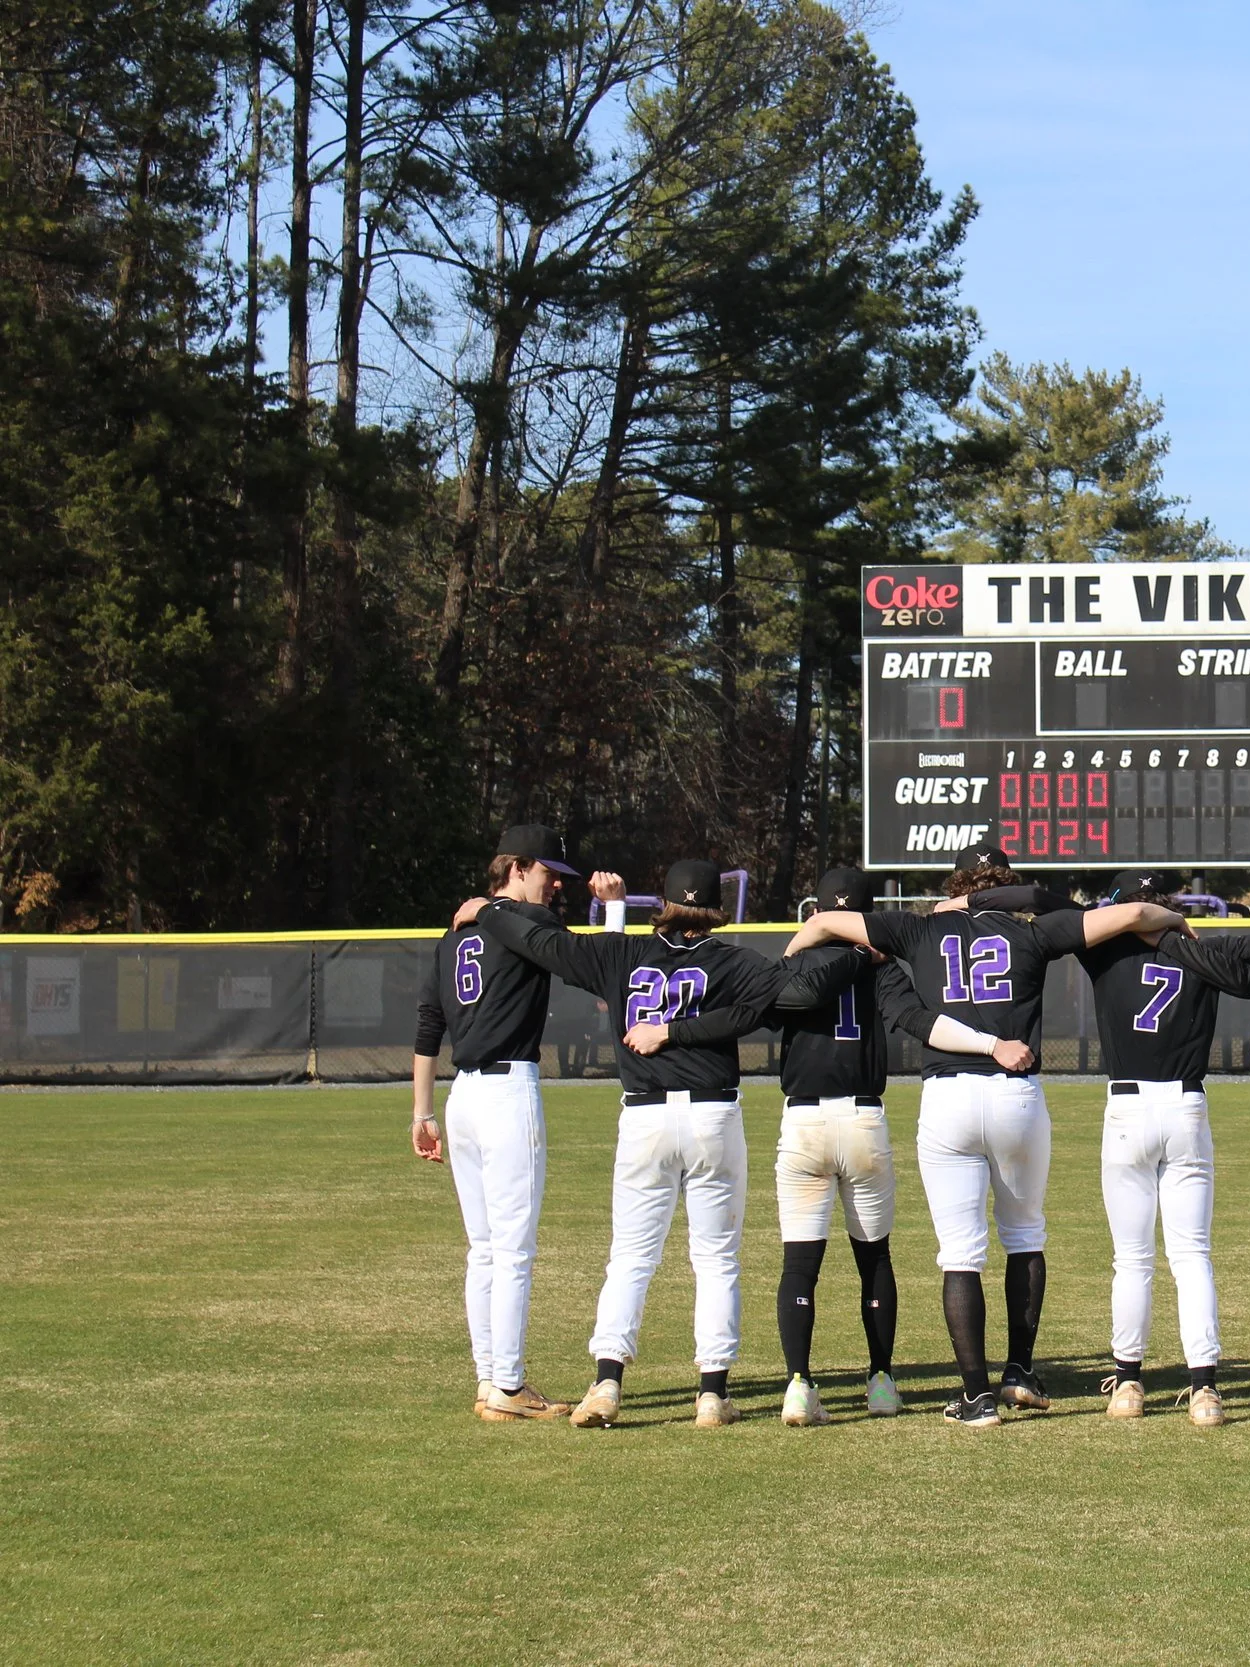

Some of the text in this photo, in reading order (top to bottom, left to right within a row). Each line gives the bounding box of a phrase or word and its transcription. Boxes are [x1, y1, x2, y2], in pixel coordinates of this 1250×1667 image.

[866, 575, 959, 609] Coke
[988, 576, 1102, 623] THE
[881, 608, 944, 626] zero
[881, 651, 993, 679] BATTER
[1054, 649, 1128, 677] BALL
[939, 687, 965, 729] 0
[1006, 751, 1015, 769] 1
[1033, 751, 1047, 769] 2
[1061, 751, 1075, 769] 3
[1090, 751, 1104, 768] 4
[1119, 750, 1133, 768] 5
[1148, 750, 1162, 768] 6
[1178, 750, 1190, 768] 7
[1206, 749, 1220, 767] 8
[1235, 749, 1248, 767] 9
[894, 777, 989, 804] GUEST
[906, 824, 989, 851] HOME
[454, 935, 485, 1005] 6
[939, 934, 1013, 1004] 12
[625, 966, 708, 1032] 20
[835, 983, 860, 1040] 1
[1132, 963, 1184, 1033] 7
